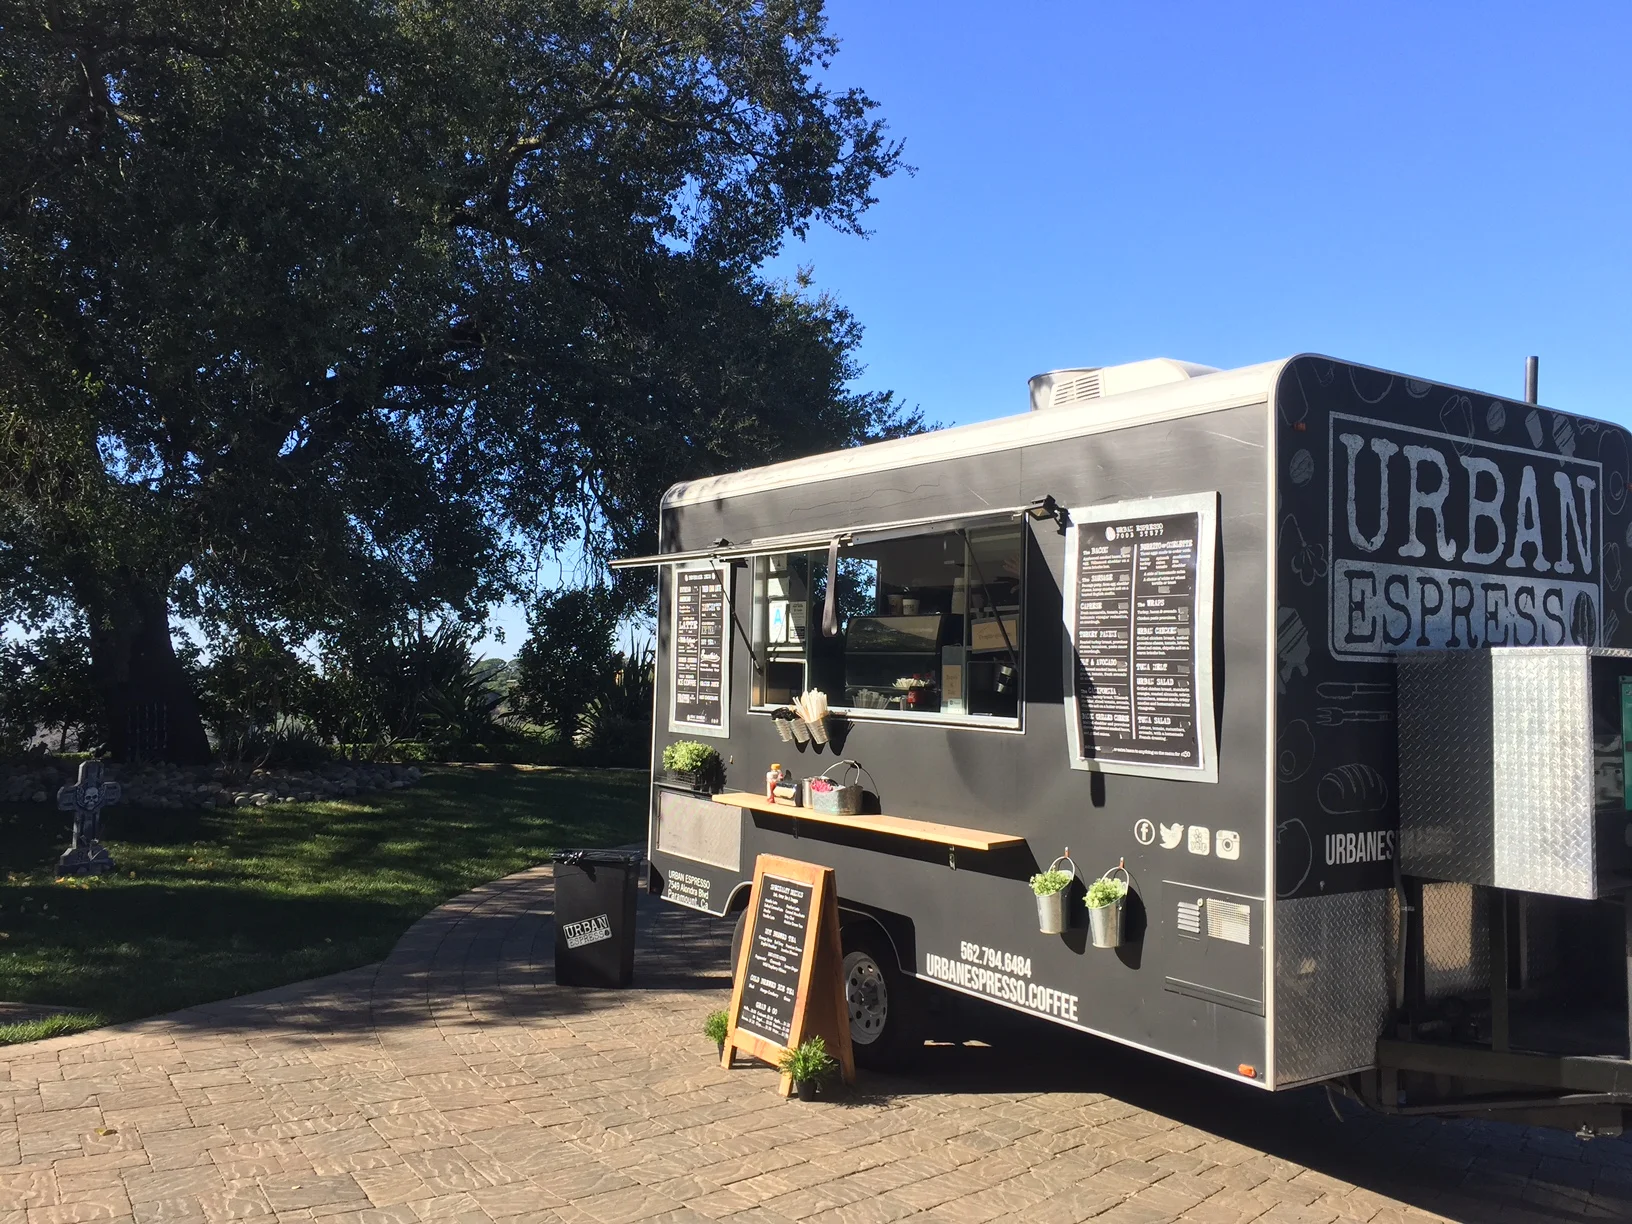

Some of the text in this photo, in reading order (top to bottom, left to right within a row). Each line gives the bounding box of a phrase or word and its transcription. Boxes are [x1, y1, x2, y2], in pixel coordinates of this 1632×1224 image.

[1339, 433, 1596, 575] URBAN
[1344, 570, 1597, 648] ESPRESSO
[1156, 677, 1174, 686] SALAD
[1154, 716, 1171, 725] SALAD
[1325, 830, 1395, 866] URBANES
[668, 869, 711, 890] URBAN ESPRESSO
[668, 880, 709, 900] 7549 Alondra Blvd
[700, 898, 709, 910] Ca
[565, 916, 607, 938] URBAN
[569, 929, 610, 947] ESPRESSO
[960, 941, 1032, 978] 562.794.6484
[926, 953, 1079, 1022] URBANESPRESSO.COFFEE
[755, 1001, 767, 1011] GRAB
